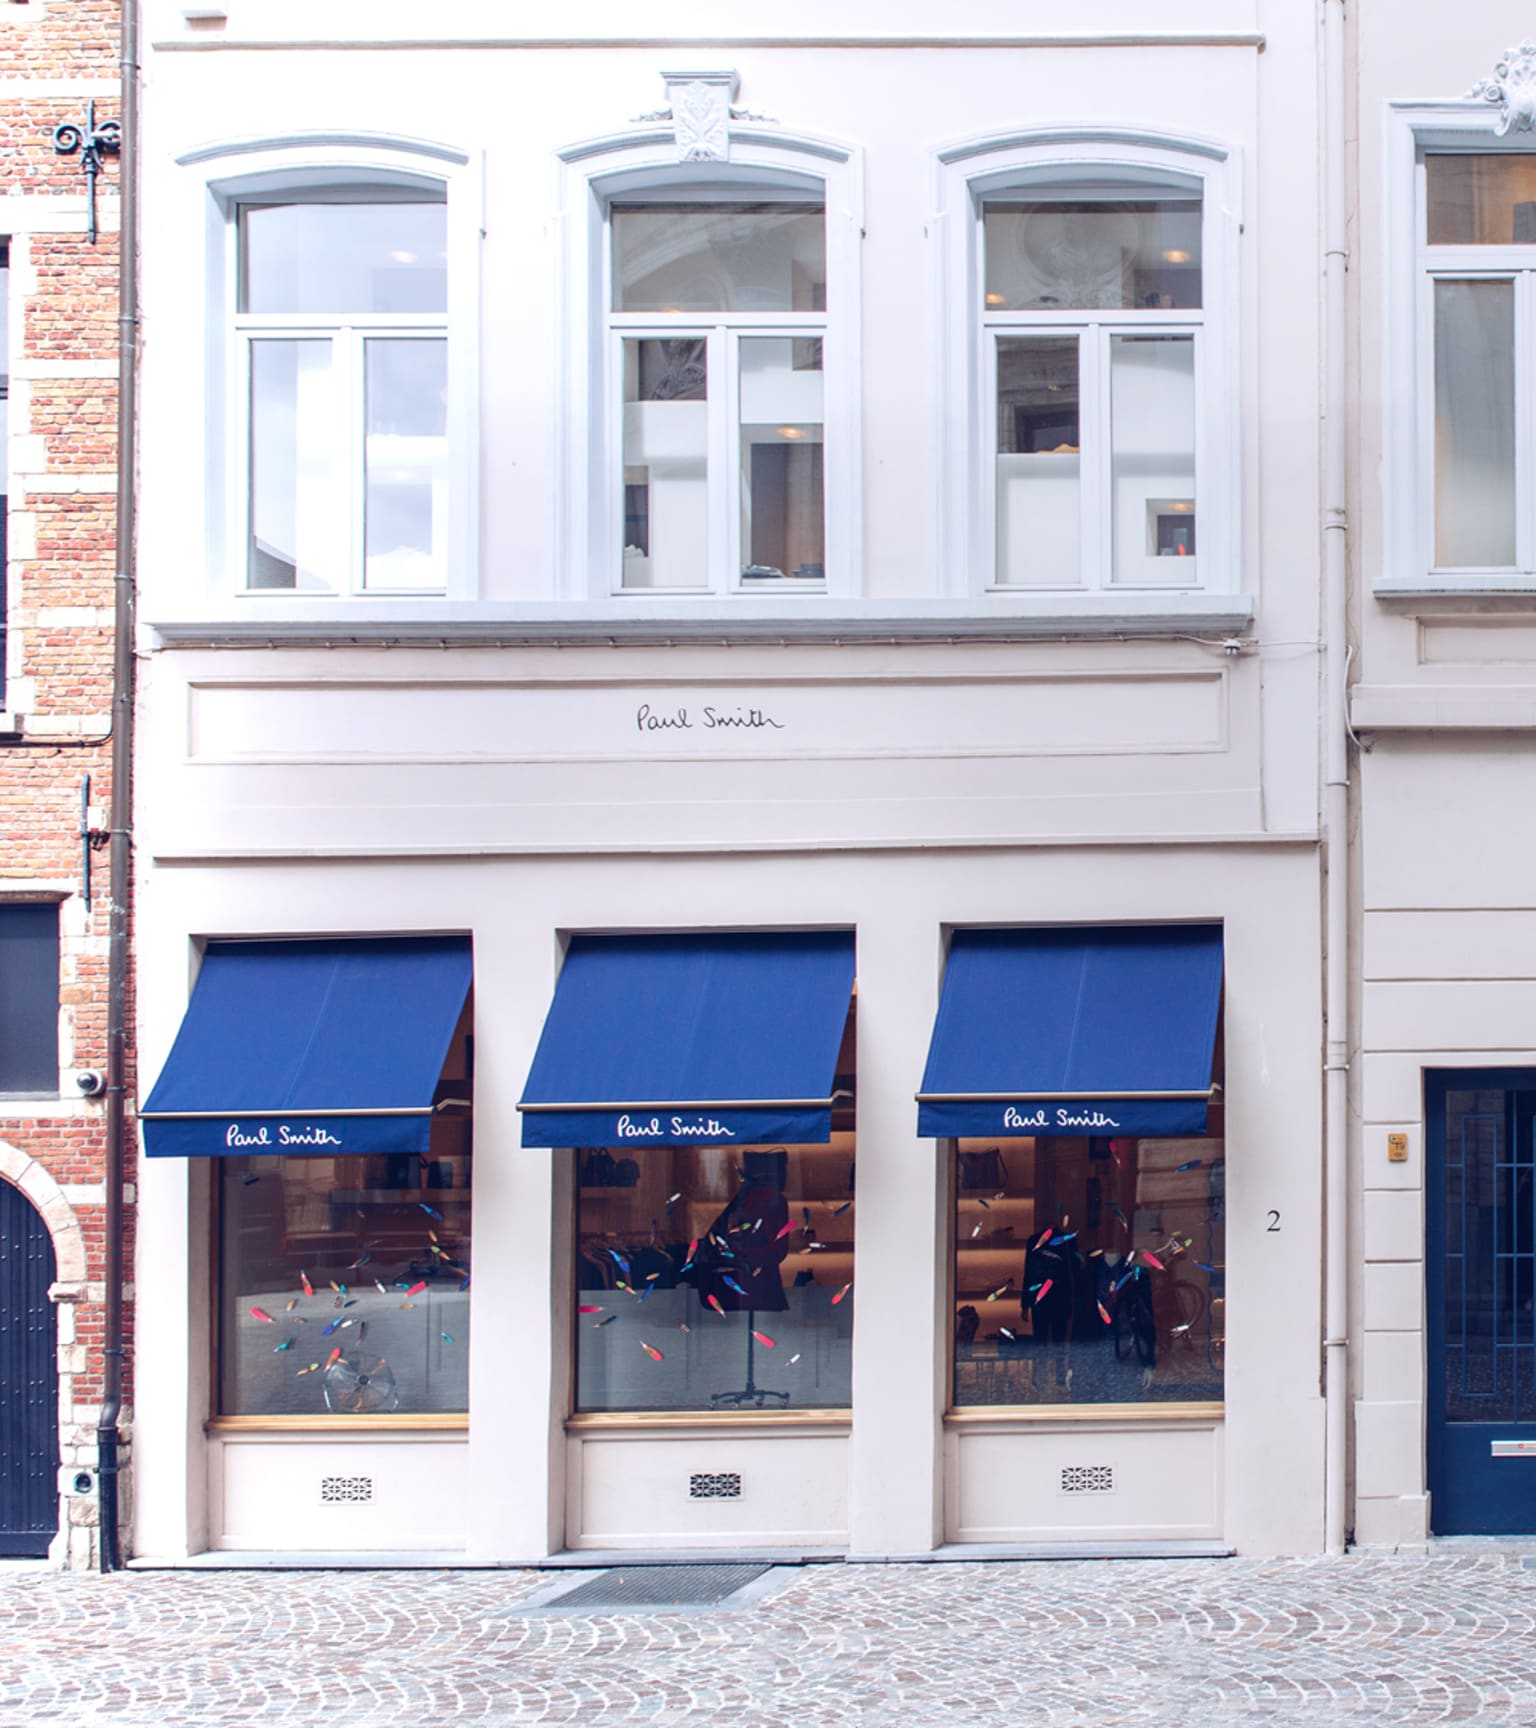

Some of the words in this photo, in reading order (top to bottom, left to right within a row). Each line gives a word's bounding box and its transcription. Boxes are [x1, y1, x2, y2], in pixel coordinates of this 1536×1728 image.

[637, 704, 693, 730] Paul
[703, 706, 785, 729] Smith
[616, 1114, 664, 1138] Paul
[670, 1116, 736, 1137] Smith
[1003, 1106, 1050, 1128] Paul
[1056, 1108, 1120, 1127] Smith
[226, 1123, 273, 1147] Paul
[278, 1125, 342, 1146] Smith
[1266, 1209, 1281, 1232] 2
